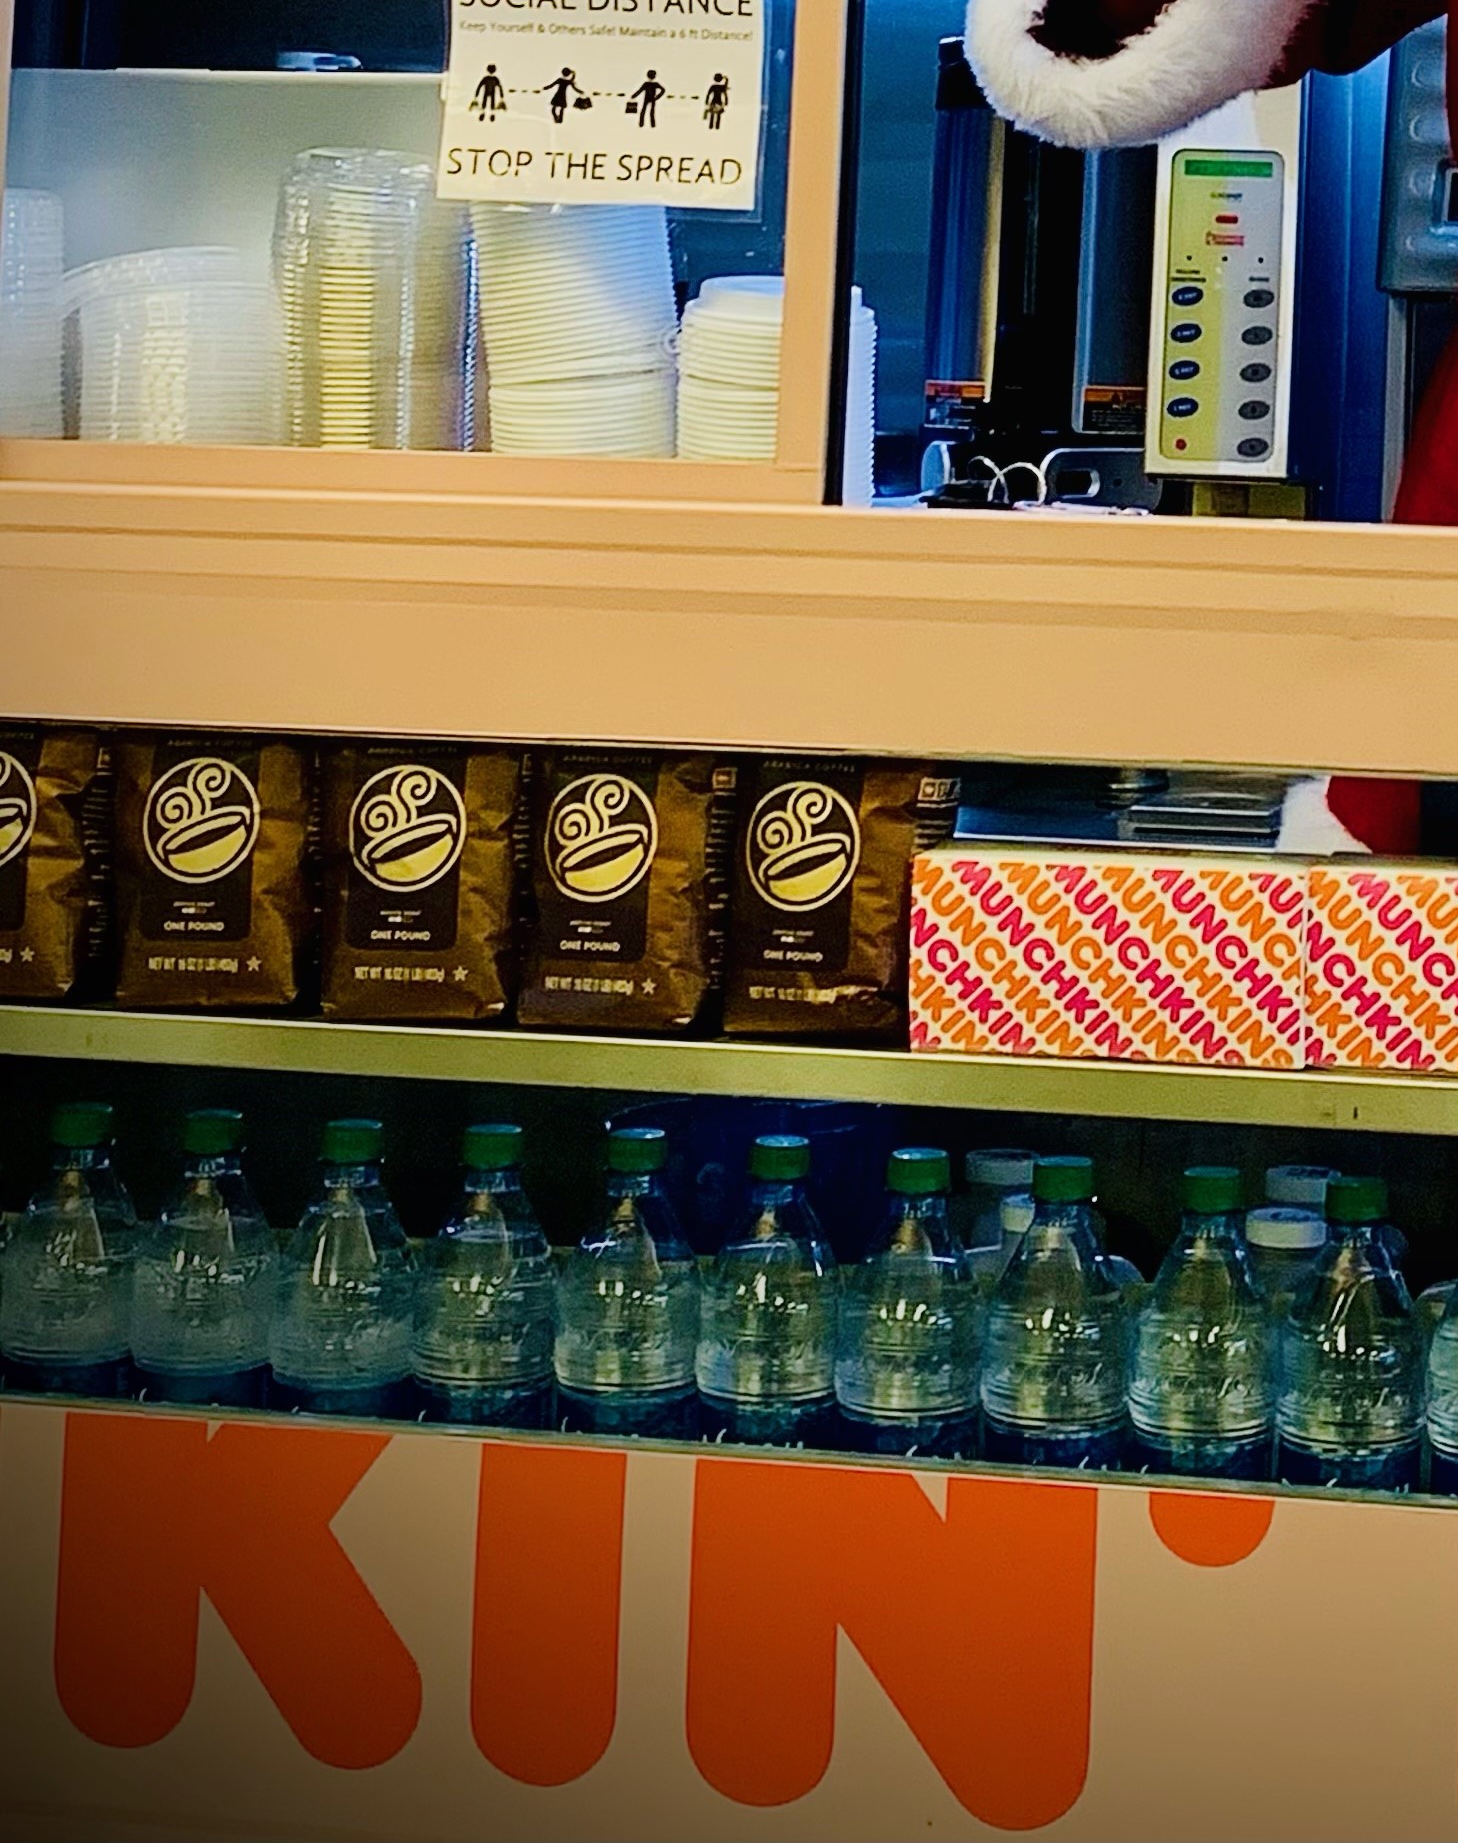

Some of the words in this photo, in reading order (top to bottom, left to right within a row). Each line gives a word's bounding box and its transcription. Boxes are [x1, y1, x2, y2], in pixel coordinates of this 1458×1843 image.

[459, 20, 486, 33] Keep
[488, 21, 534, 34] Yourself
[537, 23, 545, 34] &
[549, 23, 586, 36] Others
[619, 26, 667, 38] Maintain
[669, 29, 676, 39] a
[679, 28, 686, 39] 6
[688, 28, 699, 39] ft
[446, 148, 533, 177] STOP
[544, 152, 608, 181] THE
[616, 154, 742, 185] SPREAD
[163, 921, 186, 931] ONE
[187, 921, 225, 932] POUND
[370, 930, 392, 940] ONE
[394, 930, 431, 941] POUND
[560, 940, 582, 950] ONE
[583, 940, 621, 952] POUND
[763, 949, 784, 960] ONE
[786, 950, 823, 962] POUND
